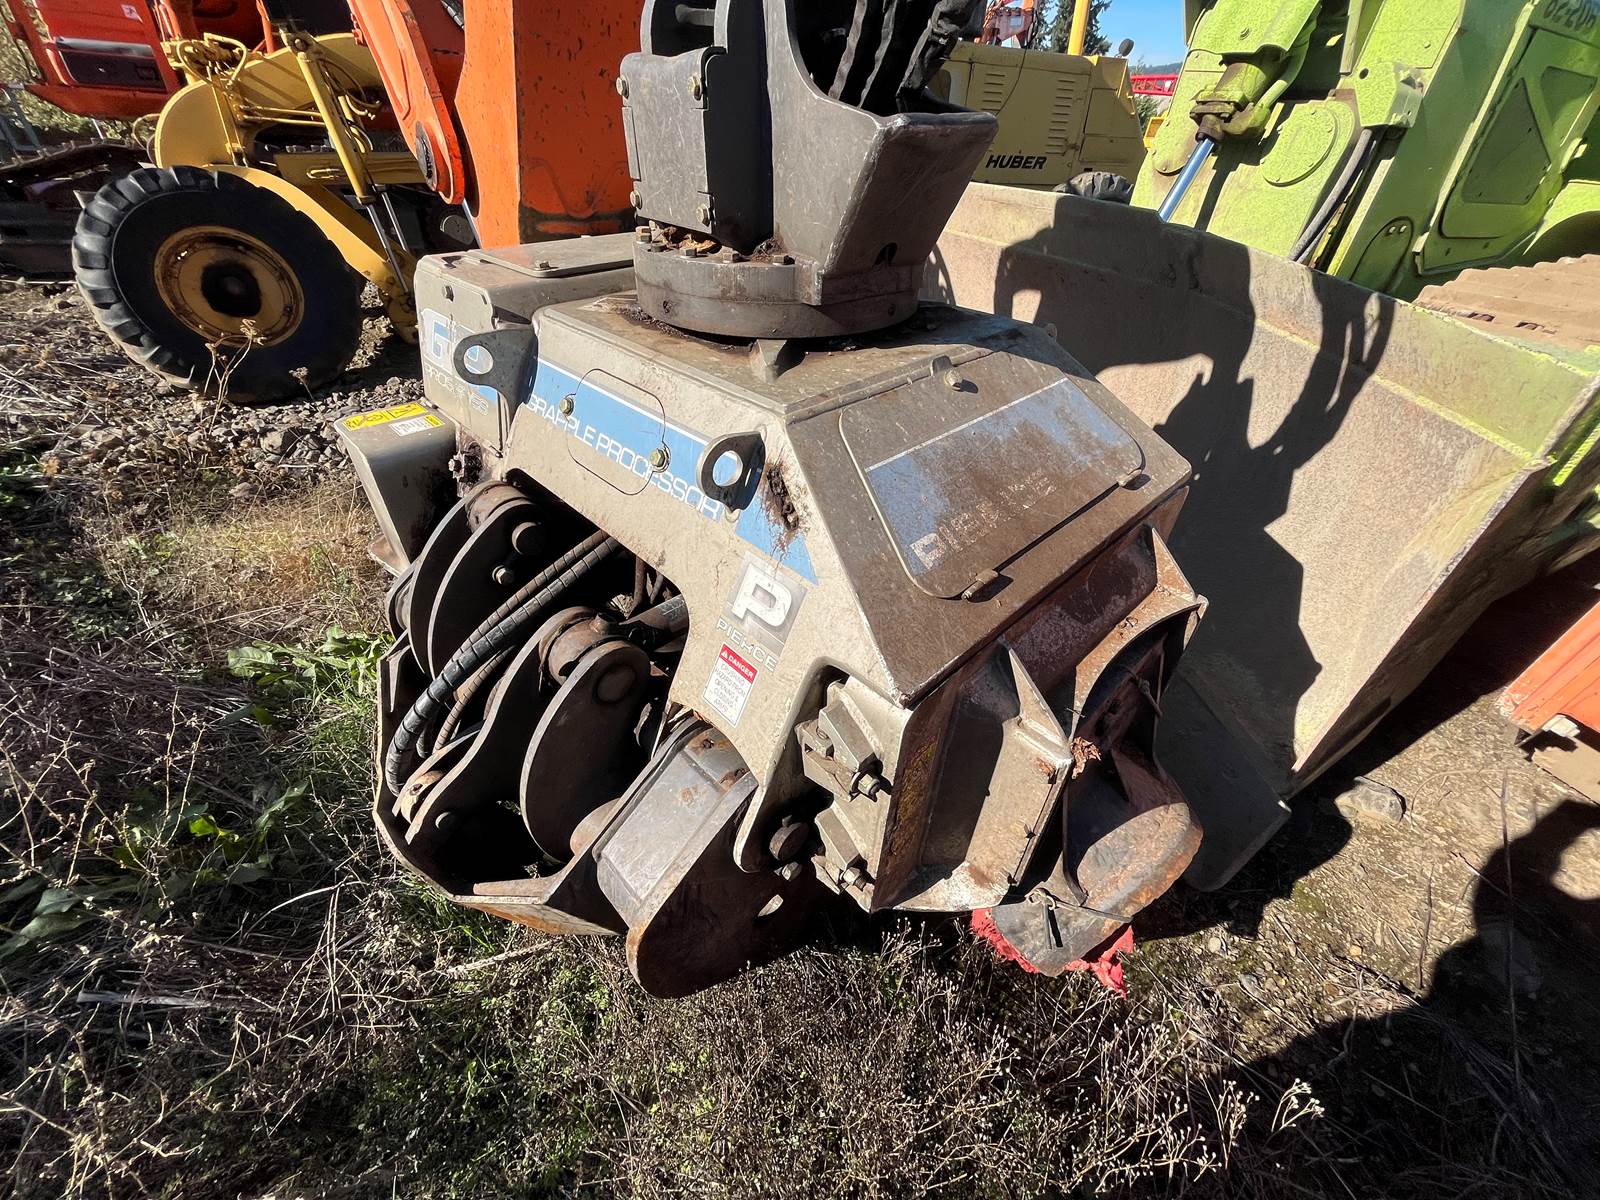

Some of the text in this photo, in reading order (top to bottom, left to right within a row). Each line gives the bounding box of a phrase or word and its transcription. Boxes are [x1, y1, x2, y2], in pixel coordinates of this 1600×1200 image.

[985, 154, 1048, 170] HUBER
[526, 394, 721, 521] GRAPPLE PROCESSOR
[731, 562, 793, 628] P
[727, 654, 754, 678] DANGER
